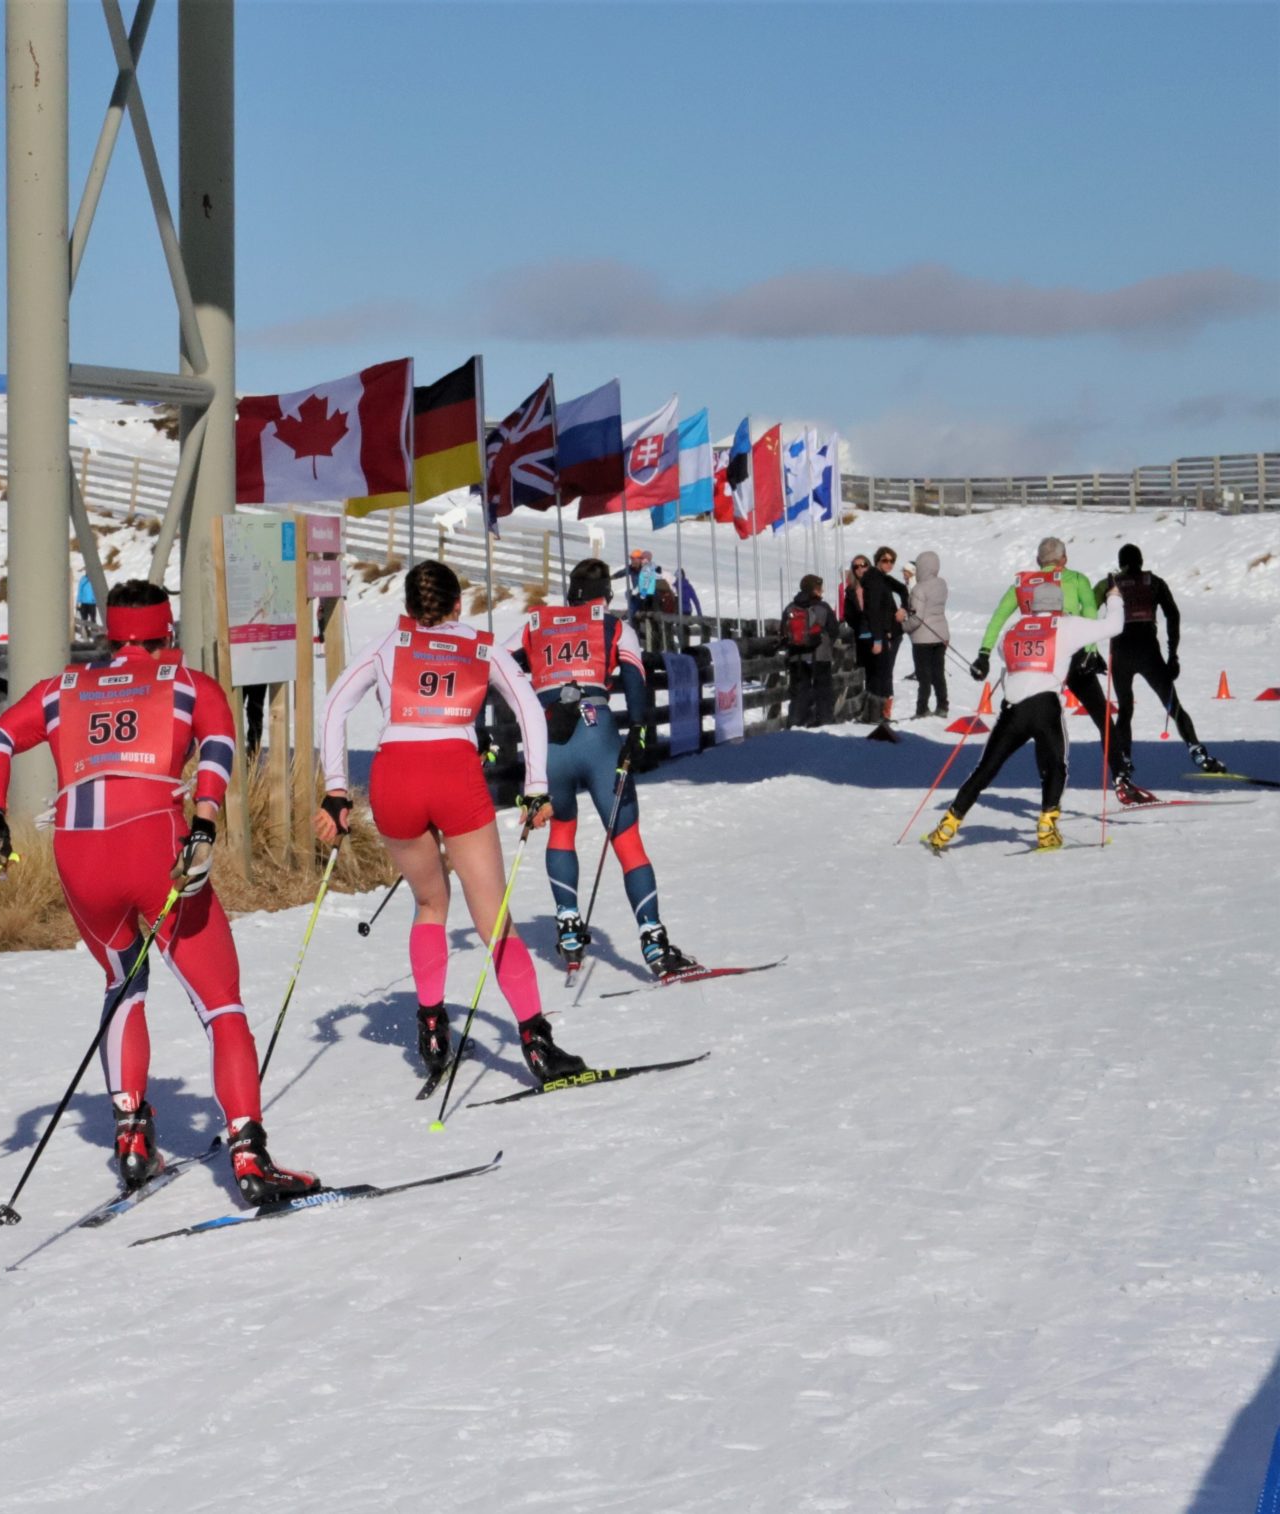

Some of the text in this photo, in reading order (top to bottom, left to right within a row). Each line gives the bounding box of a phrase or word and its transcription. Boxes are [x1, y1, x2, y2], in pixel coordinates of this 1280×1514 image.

[542, 640, 591, 667] 144
[1014, 640, 1045, 657] 135
[419, 671, 457, 698] 91
[88, 709, 138, 746] 58
[121, 752, 156, 764] MUSTER
